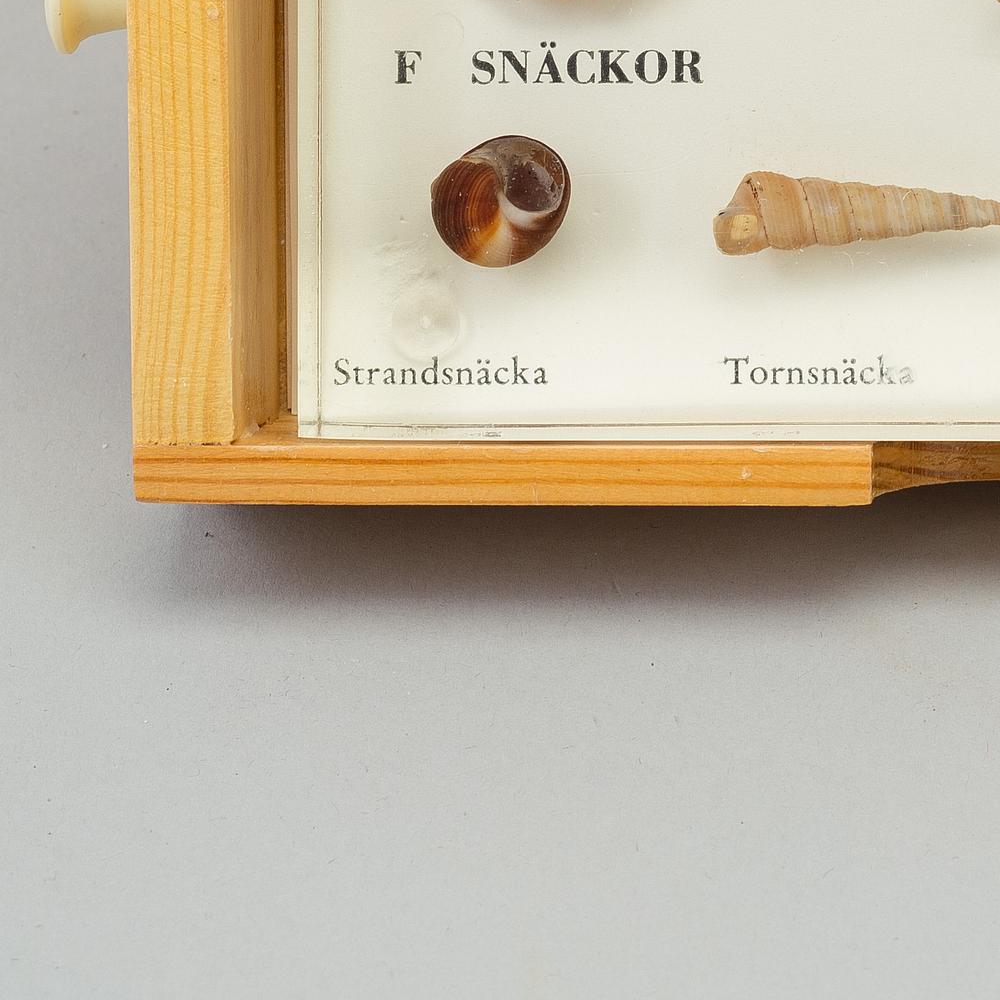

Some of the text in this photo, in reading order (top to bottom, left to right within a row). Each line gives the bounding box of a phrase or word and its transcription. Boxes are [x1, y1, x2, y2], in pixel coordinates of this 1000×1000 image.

[394, 40, 705, 86] F SNÄCKOR
[333, 355, 549, 386] Strandsnäcka
[722, 354, 915, 386] Tornsnäcka
